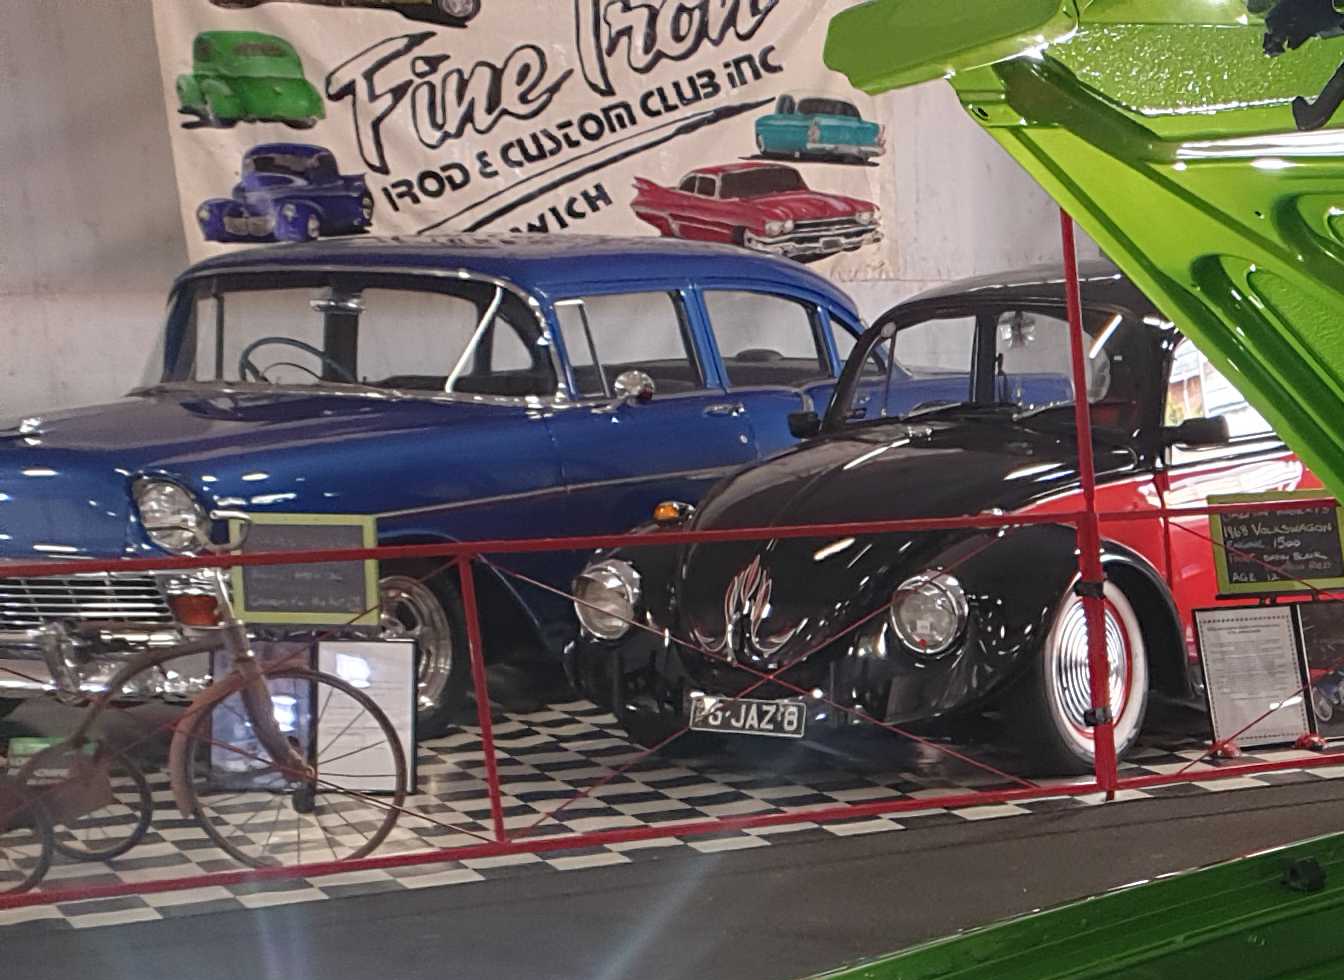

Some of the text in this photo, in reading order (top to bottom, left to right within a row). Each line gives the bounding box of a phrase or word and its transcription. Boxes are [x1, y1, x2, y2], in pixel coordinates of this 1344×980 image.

[326, 31, 574, 174] Fine
[381, 162, 472, 212] ROD
[500, 102, 638, 169] CUSTOM
[639, 69, 721, 118] CLUB
